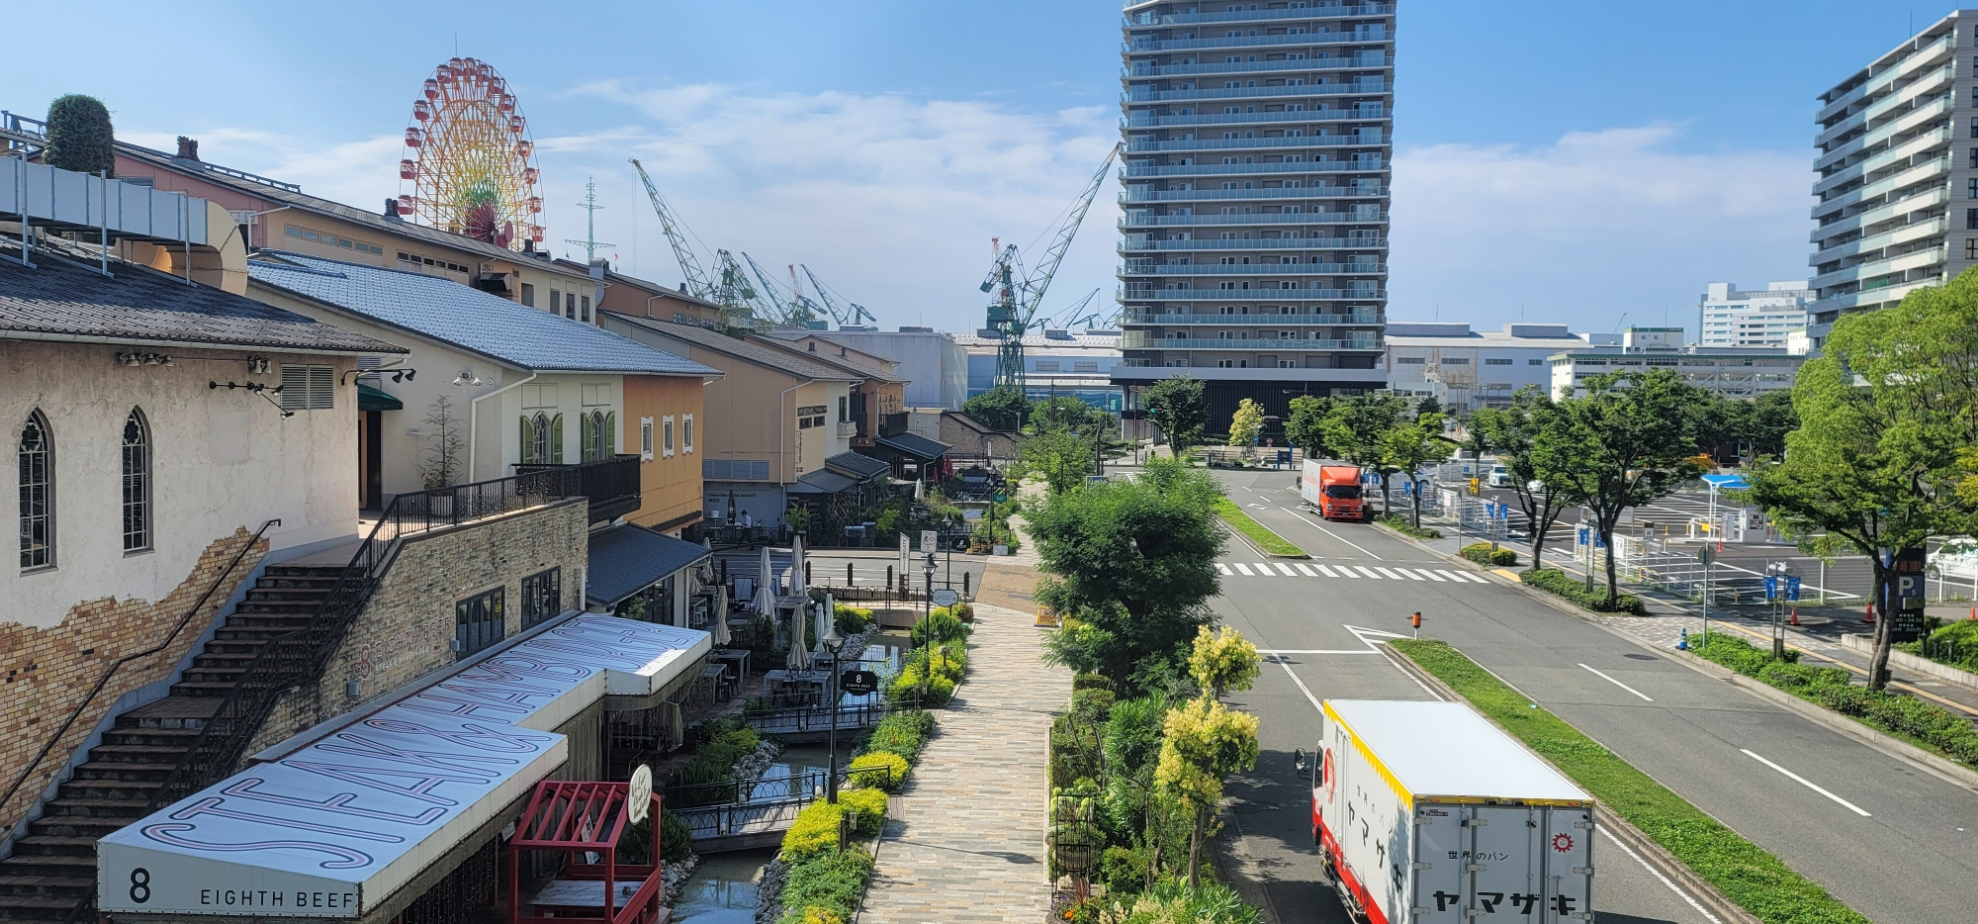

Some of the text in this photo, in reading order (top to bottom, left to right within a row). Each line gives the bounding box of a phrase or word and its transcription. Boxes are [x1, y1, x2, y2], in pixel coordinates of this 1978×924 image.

[1899, 576, 1914, 596] P
[361, 643, 371, 681] 8
[856, 674, 862, 683] 8
[140, 733, 520, 869] STEAK
[364, 718, 552, 754] &
[1448, 850, 1509, 861] 世界のパン
[130, 868, 150, 903] 8
[200, 889, 353, 909] EIGHTH BEEF
[1433, 890, 1576, 916] ヤマザキ
